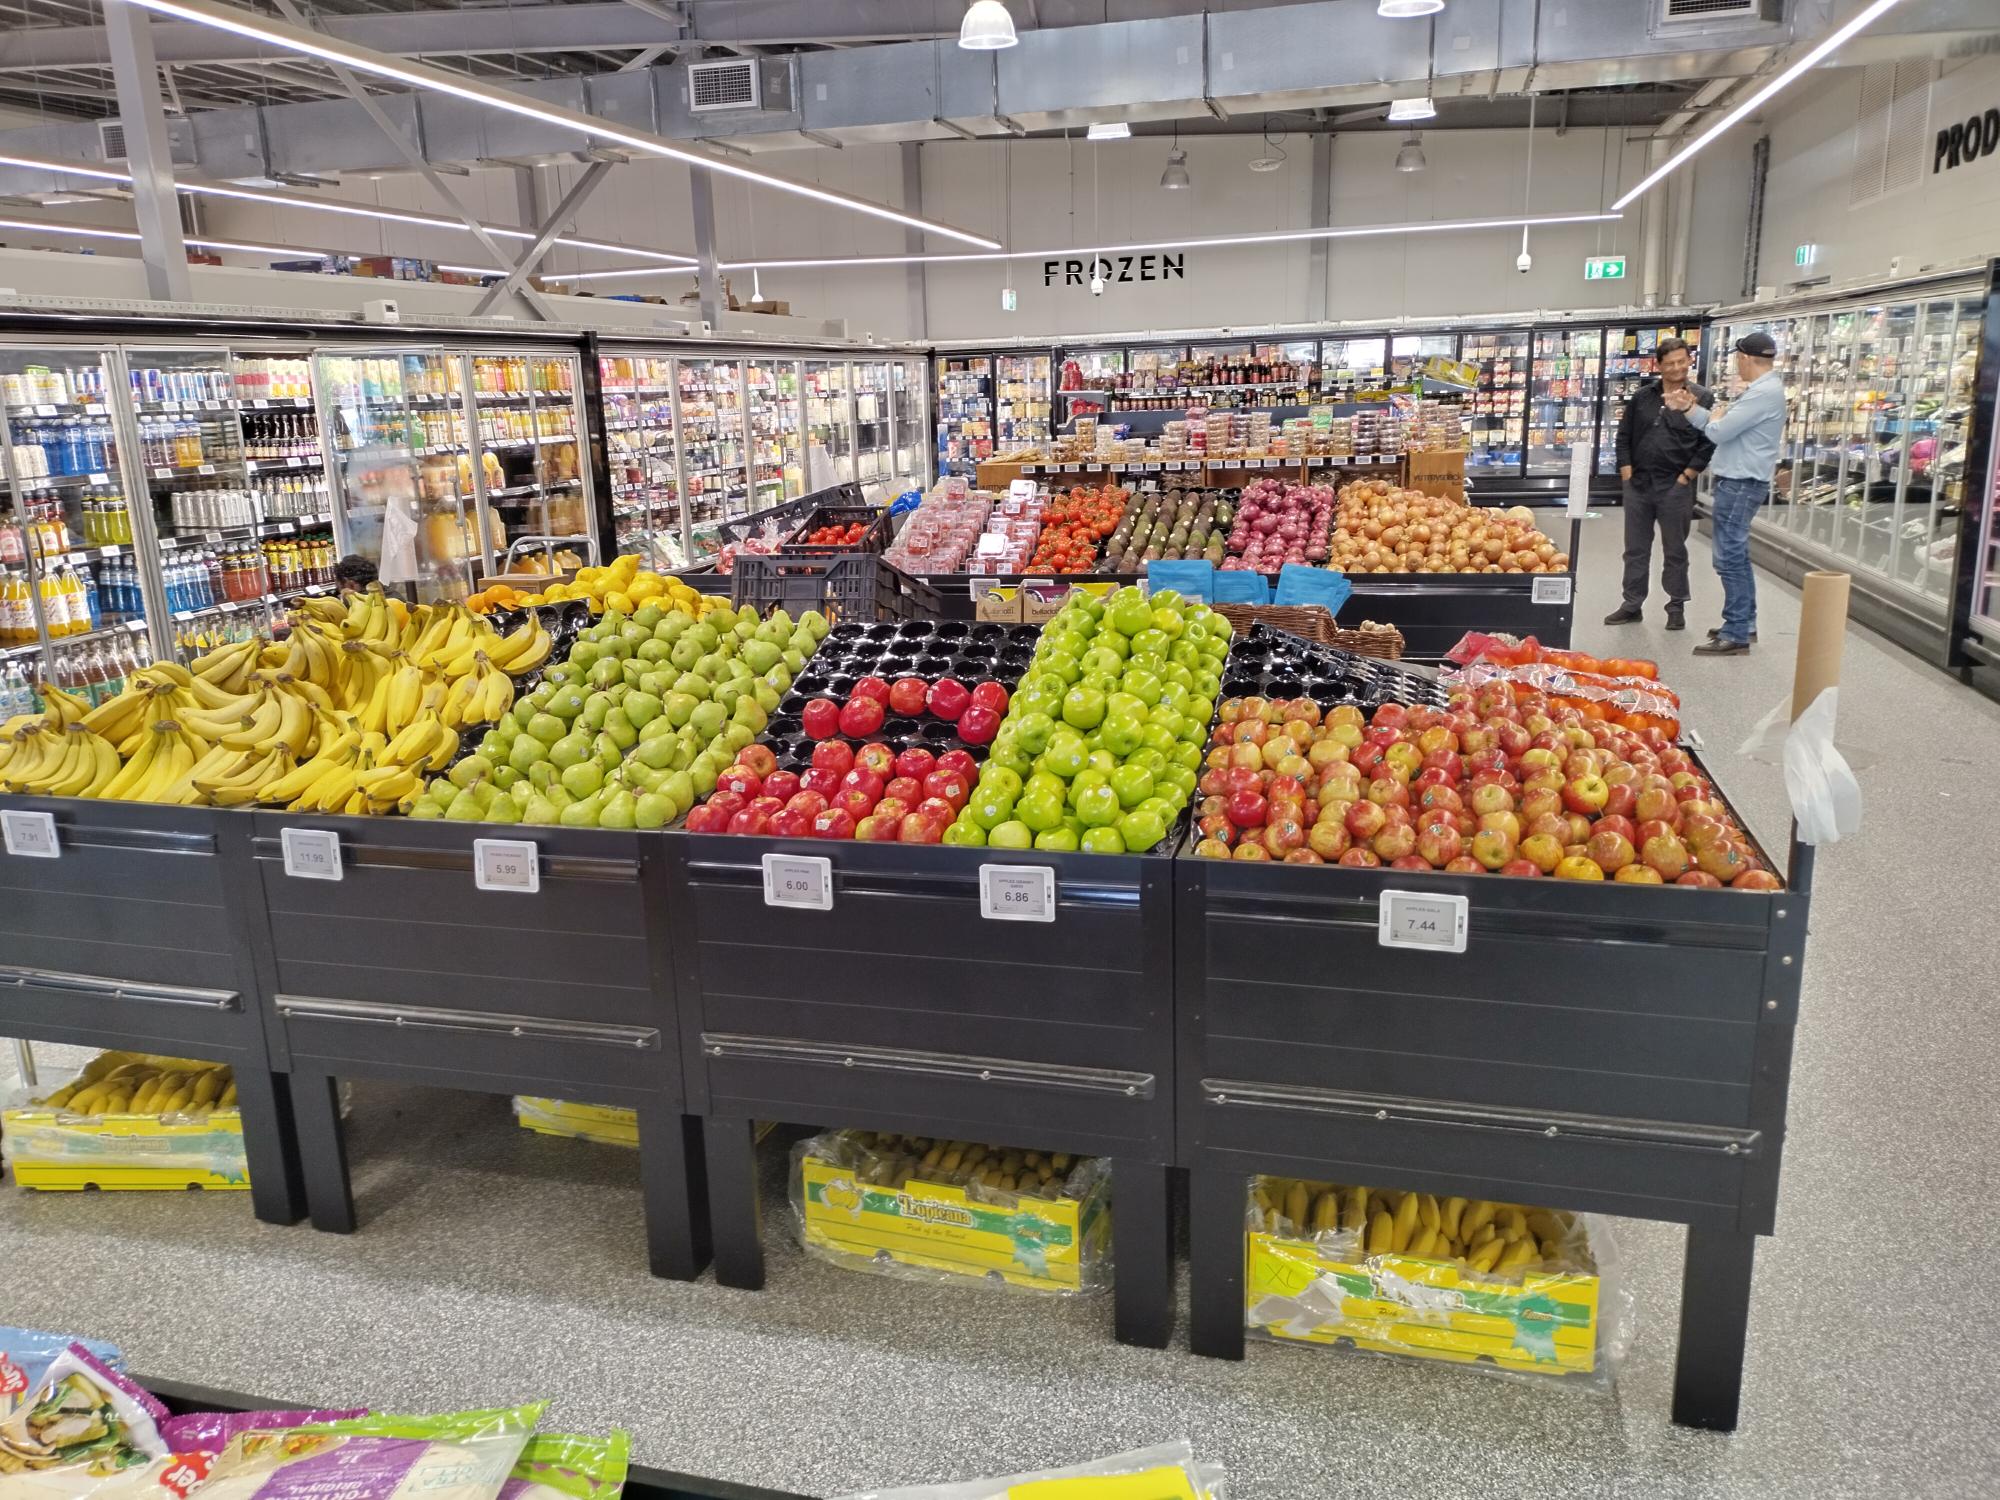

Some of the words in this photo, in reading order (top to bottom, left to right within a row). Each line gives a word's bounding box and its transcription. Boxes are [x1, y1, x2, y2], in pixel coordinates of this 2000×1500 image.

[1044, 253, 1184, 286] FROZEN
[496, 864, 517, 874] 5.99
[786, 880, 809, 890] 6.00
[1004, 891, 1029, 902] 6.86
[1408, 919, 1436, 931] 7.44
[898, 1192, 974, 1226] Tropicana
[288, 1481, 362, 1493] ORIGINAL
